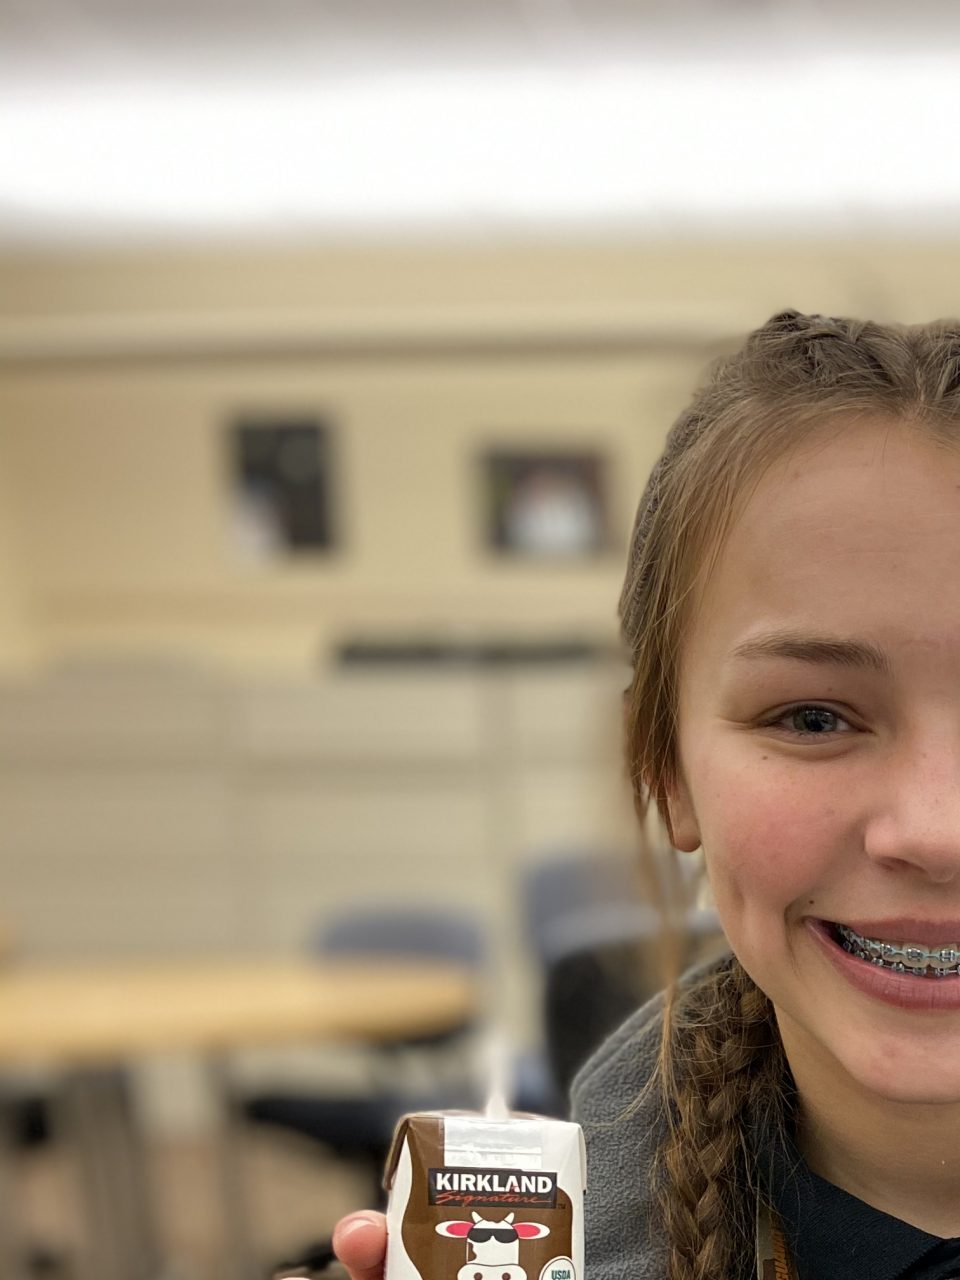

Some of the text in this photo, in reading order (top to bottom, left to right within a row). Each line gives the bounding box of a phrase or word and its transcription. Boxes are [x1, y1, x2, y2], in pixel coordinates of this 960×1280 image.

[436, 1173, 553, 1193] KIRKLAND
[436, 1191, 552, 1207] Signature
[551, 1269, 571, 1280] USDA
